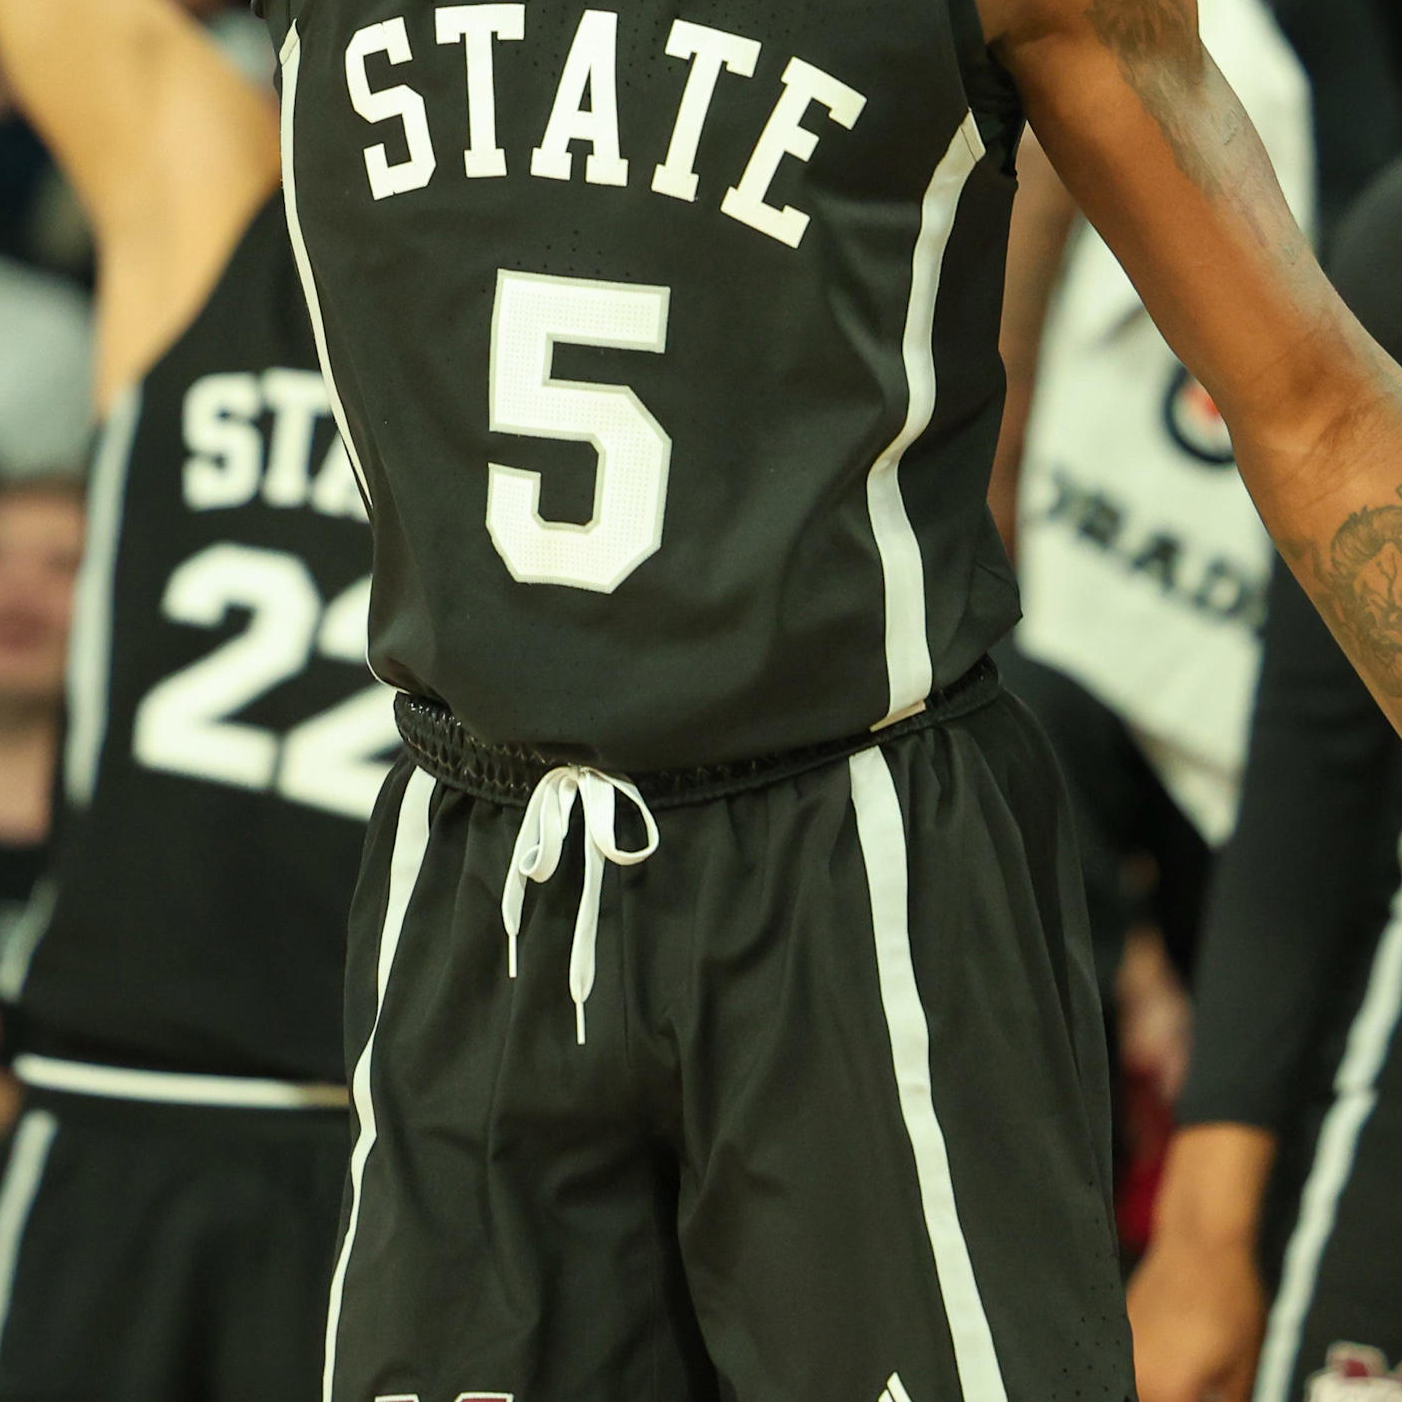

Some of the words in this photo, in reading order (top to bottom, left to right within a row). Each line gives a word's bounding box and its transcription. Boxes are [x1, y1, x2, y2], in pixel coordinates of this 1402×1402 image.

[344, 2, 868, 249] STATE
[485, 267, 673, 594] 5
[132, 541, 400, 824] 22
